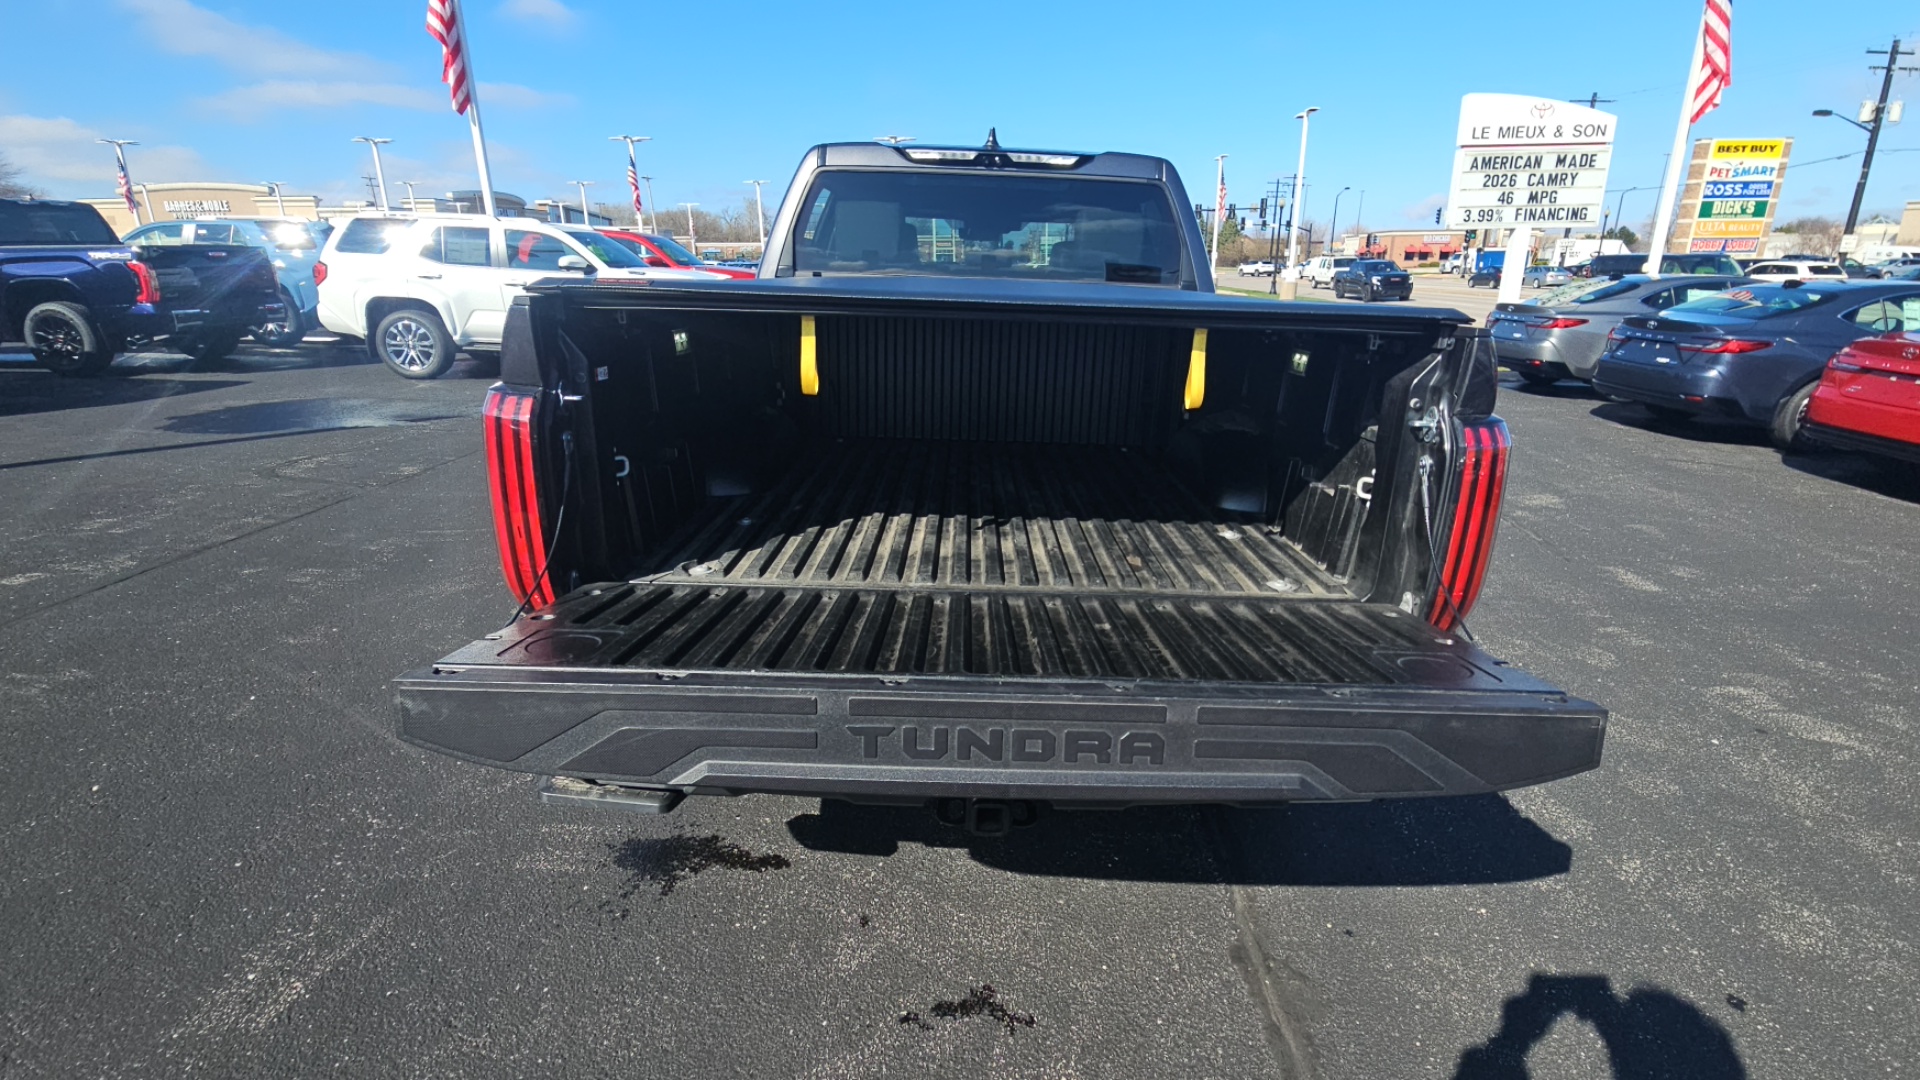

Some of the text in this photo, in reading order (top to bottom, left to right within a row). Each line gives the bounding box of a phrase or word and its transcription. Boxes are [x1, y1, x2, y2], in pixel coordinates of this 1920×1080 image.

[1472, 124, 1608, 140] LE MIEUX & SON
[1717, 144, 1778, 153] BEST BUY
[1469, 153, 1598, 171] AMERICAN MADE
[1482, 172, 1579, 188] 2026 CAMRY
[1704, 183, 1744, 196] ROSS
[1497, 190, 1558, 205] 46 MPG
[1712, 200, 1756, 214] DICK'S
[1463, 207, 1588, 223] 3.99% FINANCING
[1698, 221, 1726, 232] ULTA
[1691, 239, 1758, 252] HOBBY LOBBY
[845, 725, 1166, 765] TUNDRA
